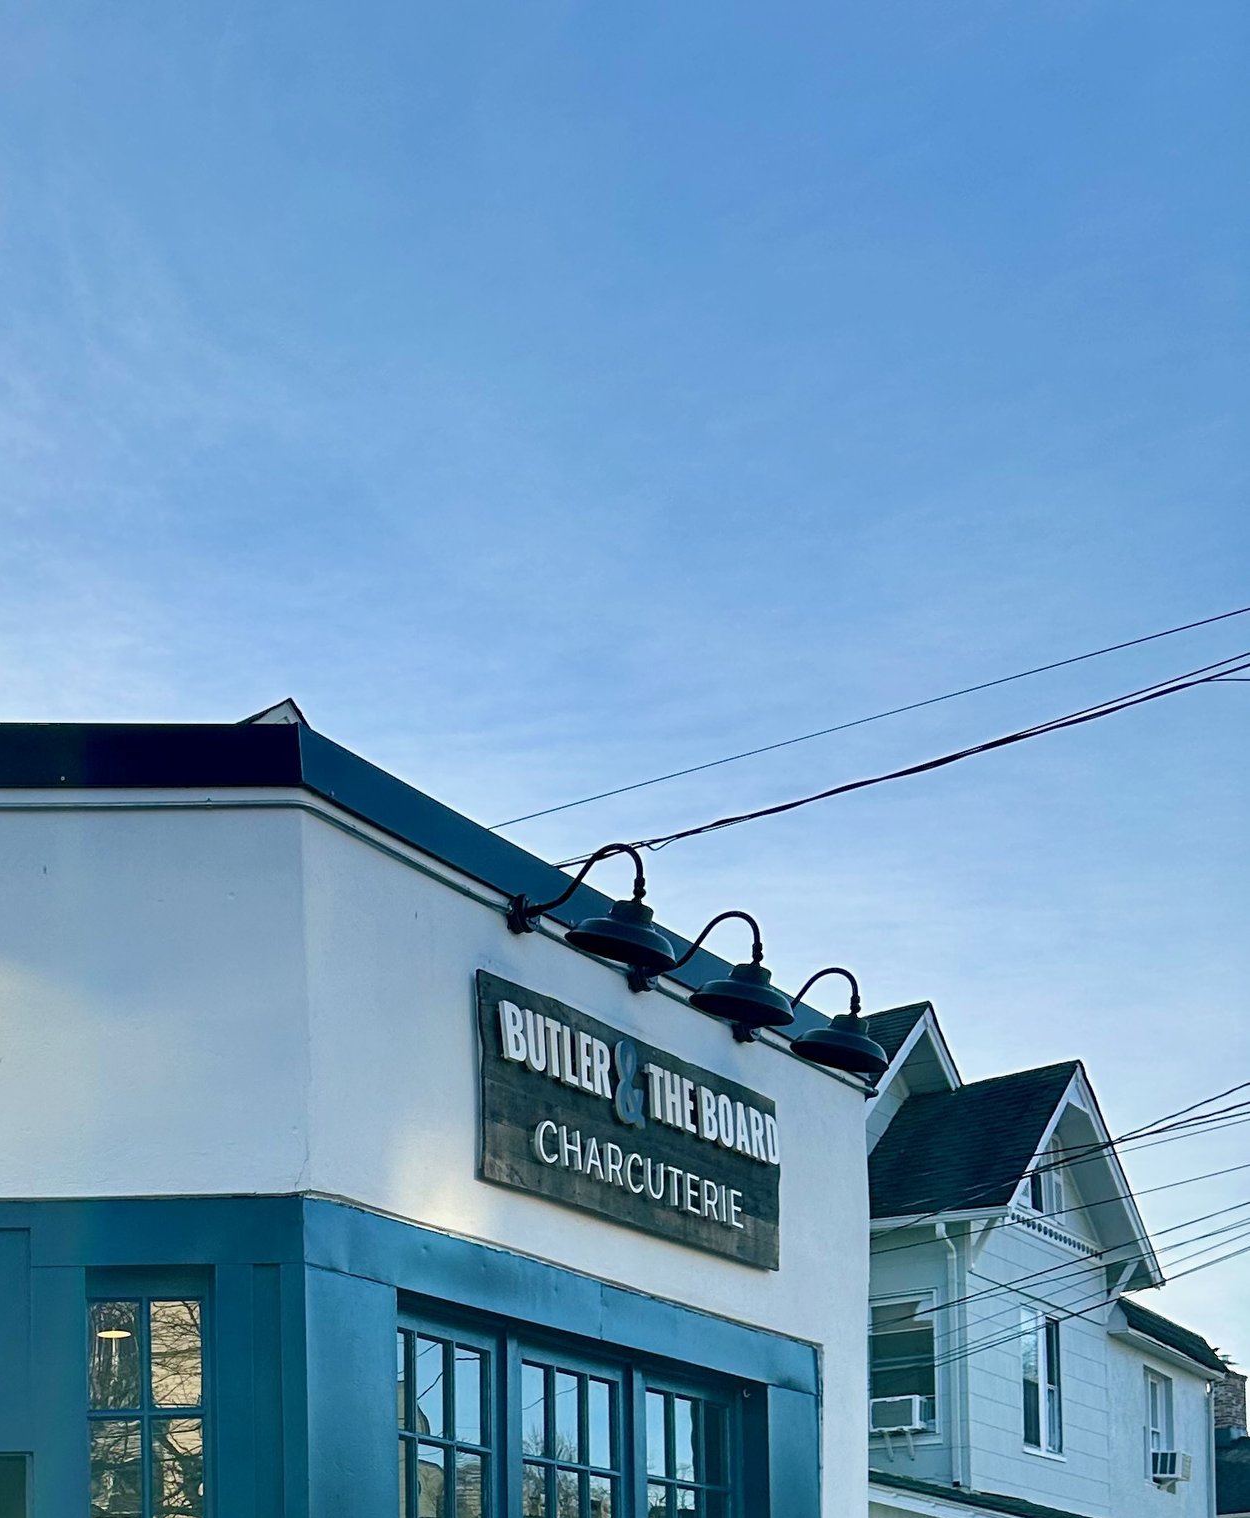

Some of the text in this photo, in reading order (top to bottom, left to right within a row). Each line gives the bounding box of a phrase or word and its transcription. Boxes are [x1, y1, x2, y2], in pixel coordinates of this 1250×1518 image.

[498, 1000, 781, 1166] BUTLER & THE BOARD
[533, 1120, 745, 1230] CHARCUTERIE
